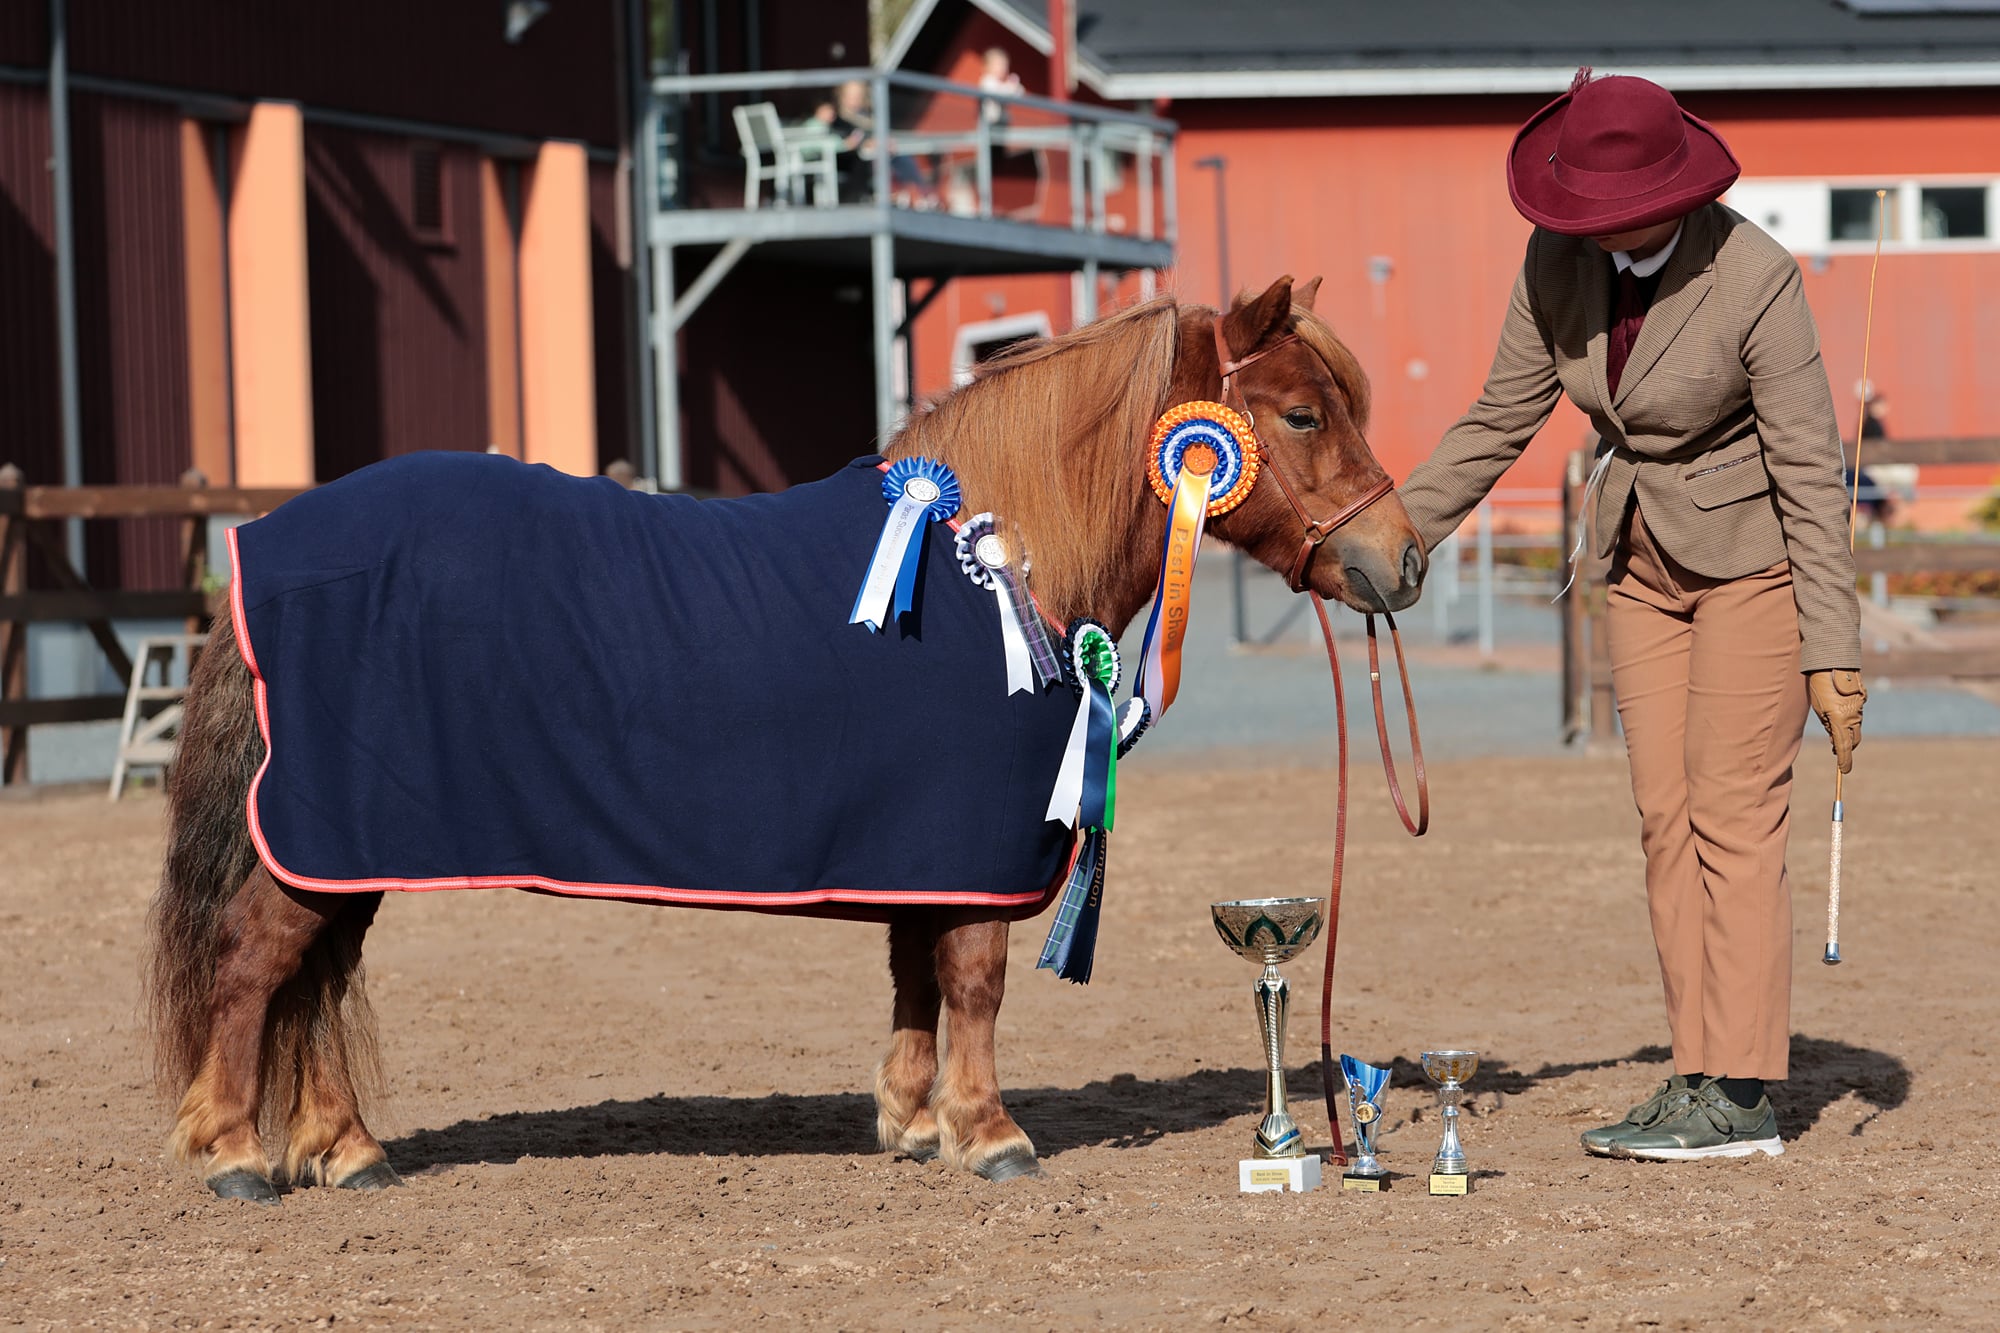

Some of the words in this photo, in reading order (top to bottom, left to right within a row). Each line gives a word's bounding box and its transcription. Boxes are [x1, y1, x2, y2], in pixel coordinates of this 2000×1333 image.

[1171, 527, 1189, 575] Best
[1168, 582, 1184, 600] in
[1166, 606, 1183, 652] Show
[1089, 833, 1105, 908] ampion
